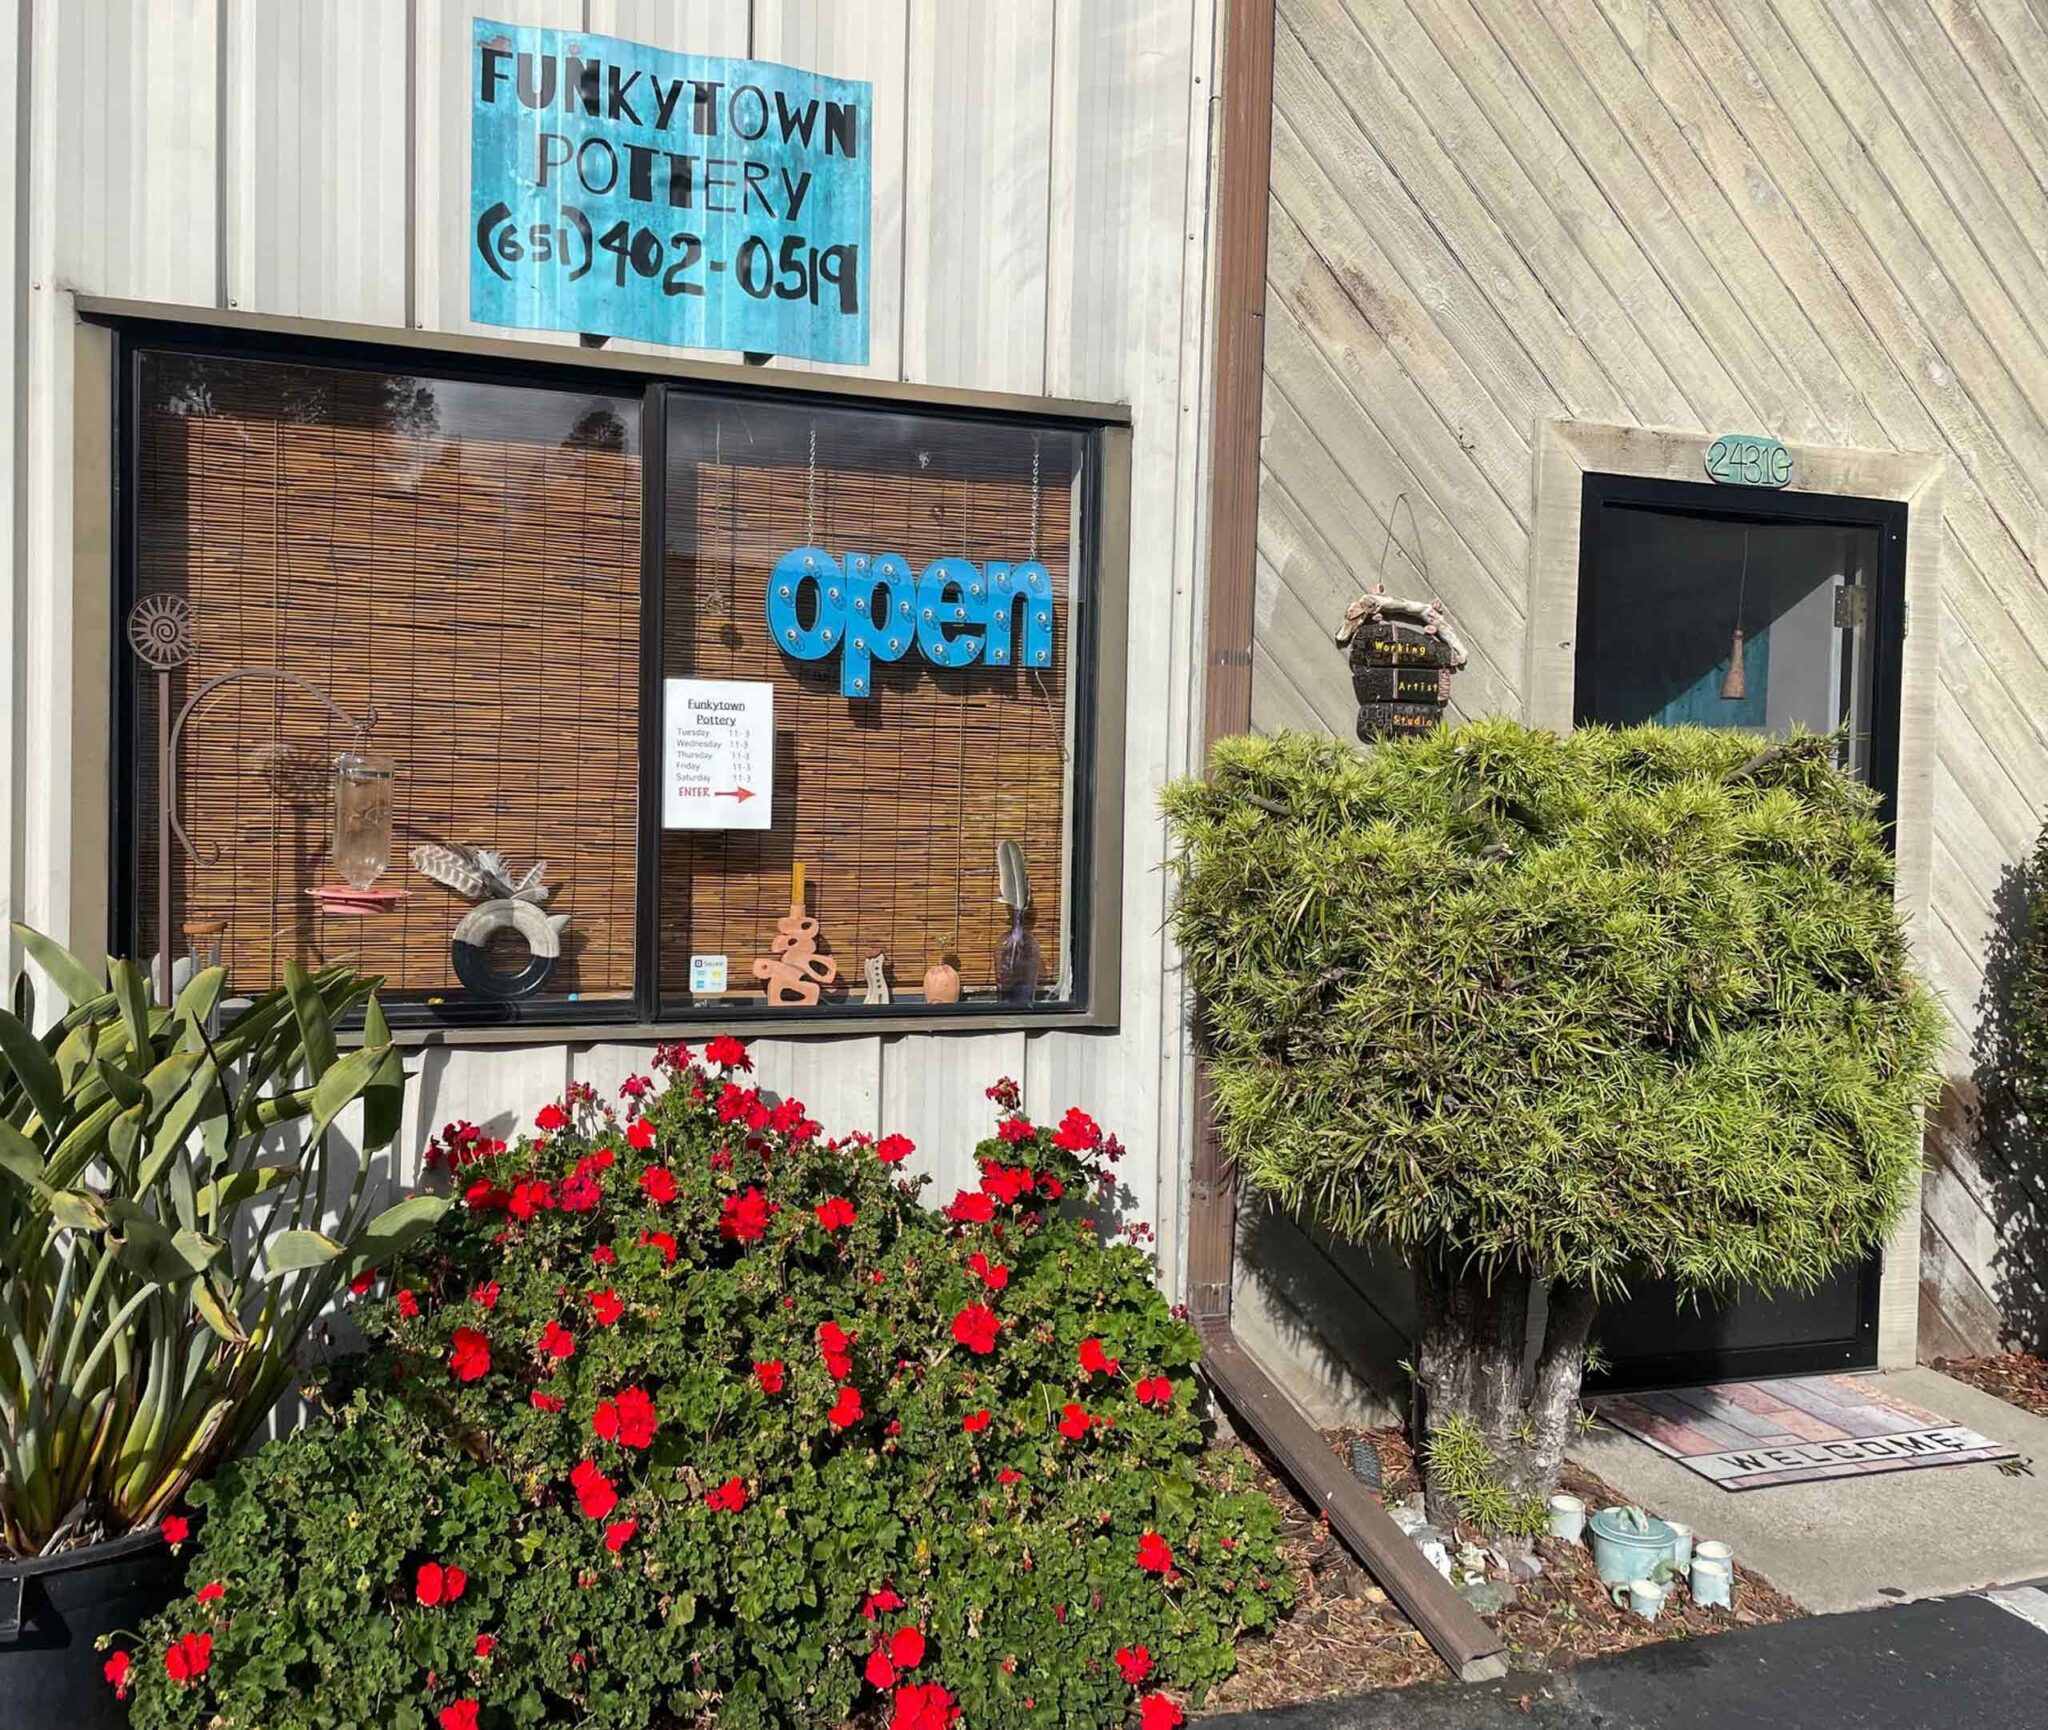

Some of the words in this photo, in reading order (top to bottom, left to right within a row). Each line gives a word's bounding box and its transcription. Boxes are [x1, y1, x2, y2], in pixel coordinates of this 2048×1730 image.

[480, 47, 857, 159] FUNKYTOWN
[536, 133, 812, 221] POTTERY
[1710, 441, 1793, 484] 2431G
[766, 546, 1053, 697] open
[1374, 641, 1426, 655] Working
[1398, 682, 1439, 692] Artist
[688, 698, 745, 712] Funkytown
[696, 714, 737, 727] Pottery
[1393, 715, 1434, 727] Studio
[677, 728, 710, 738] Tuesday
[676, 739, 722, 749] Wednesday
[677, 750, 713, 760] Thursday
[676, 762, 701, 771] Friday
[676, 773, 711, 783] Saturday
[678, 786, 710, 797] ENTER
[1718, 1433, 1961, 1472] WELCOME
